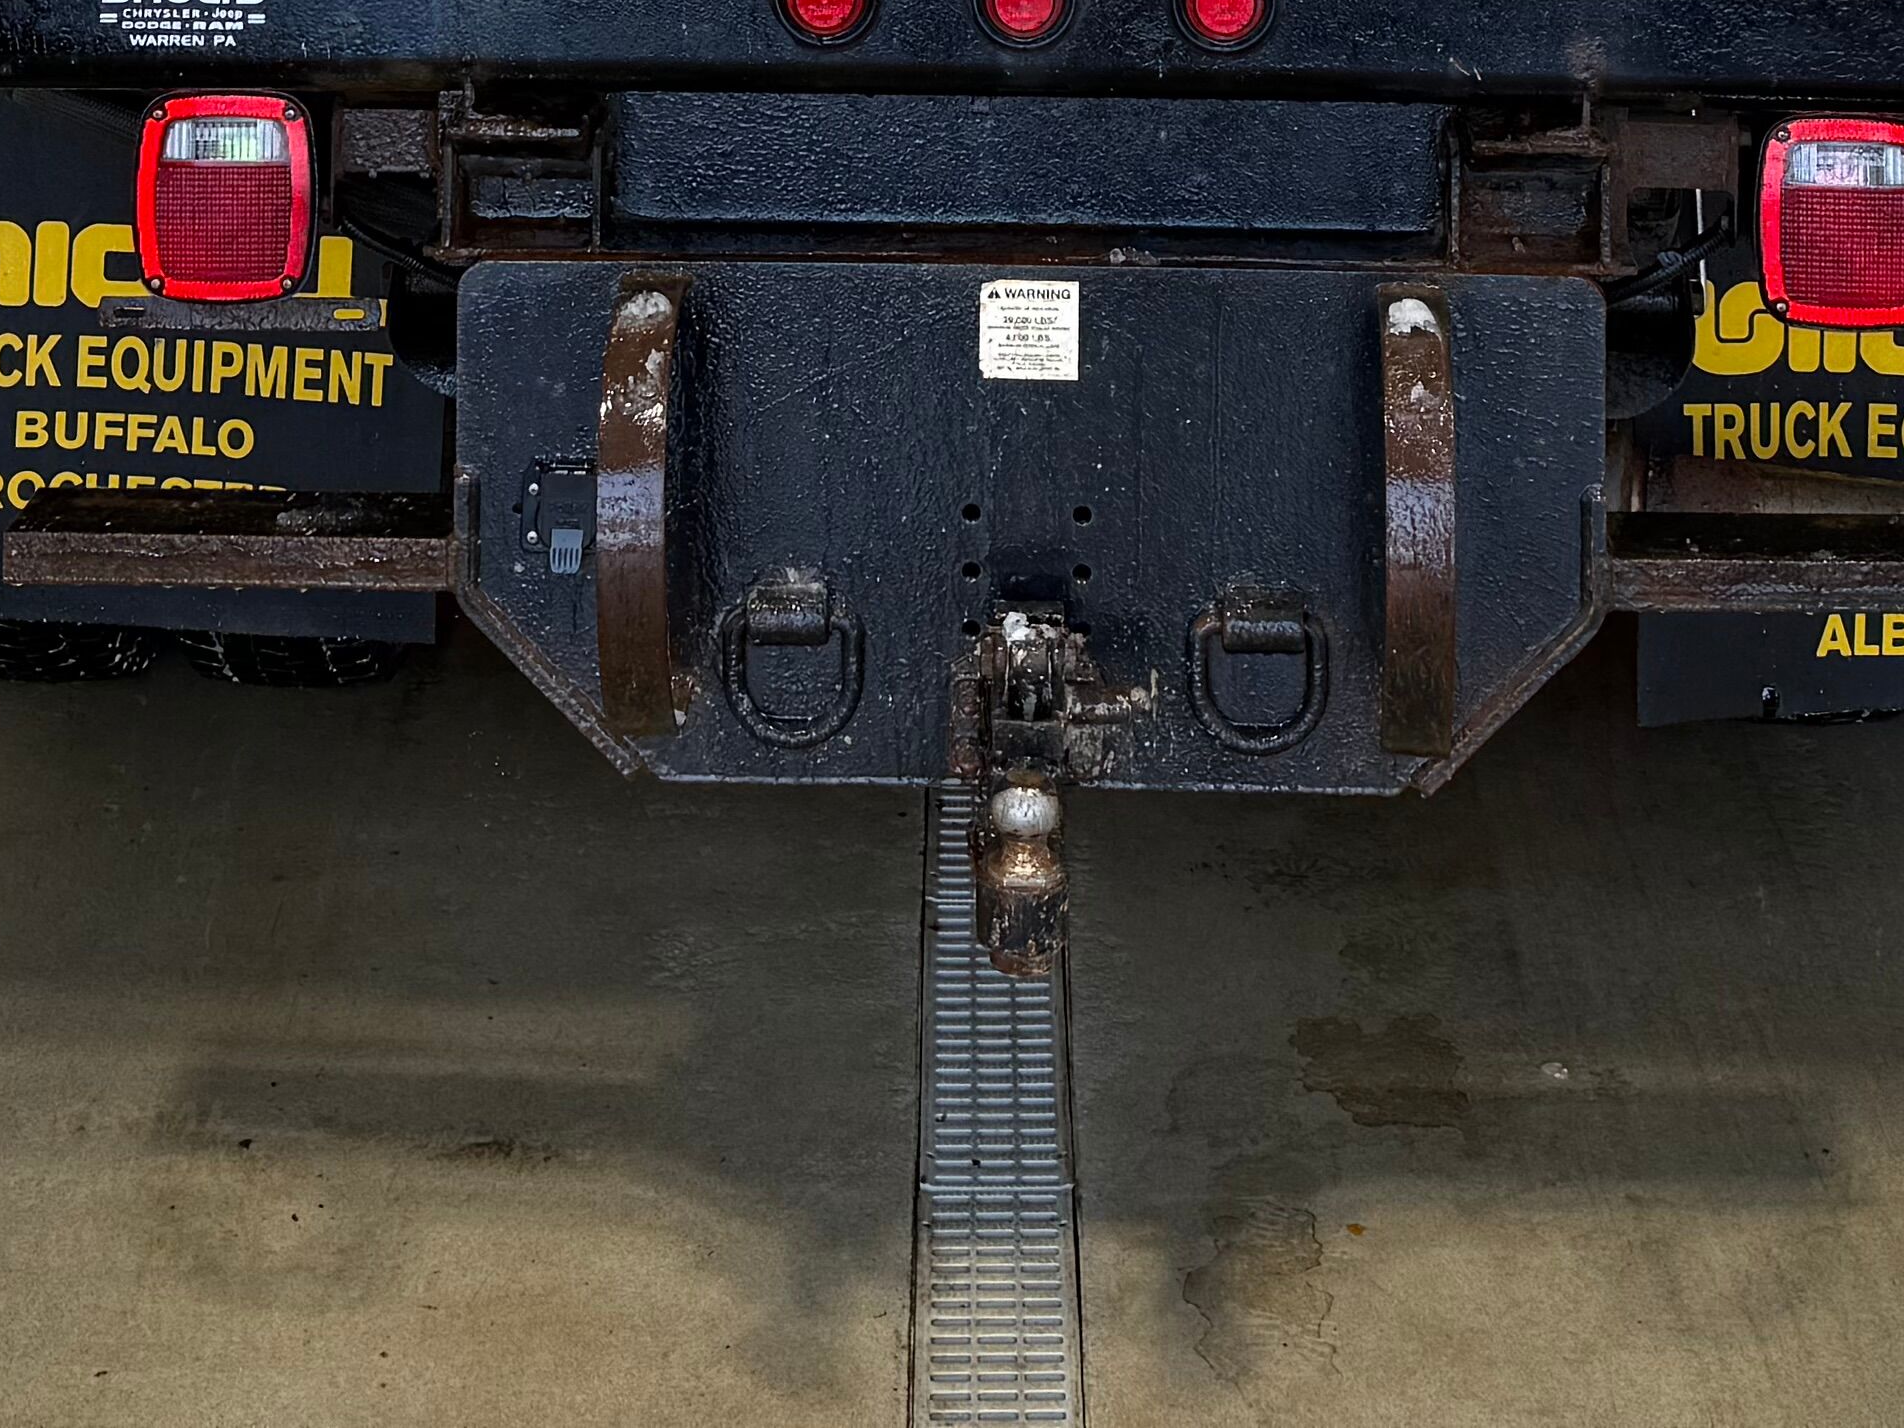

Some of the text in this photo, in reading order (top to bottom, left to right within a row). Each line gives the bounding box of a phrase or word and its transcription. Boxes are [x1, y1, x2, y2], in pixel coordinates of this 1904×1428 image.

[122, 7, 244, 20] CHRYSLER Jeep
[121, 21, 244, 31] DODGE RAM
[129, 34, 237, 47] WARREN PA
[1004, 288, 1072, 300] WARNING
[76, 335, 394, 408] EQUIPMENT
[14, 410, 255, 459] BUFFALO
[1683, 401, 1853, 461] TRUCK
